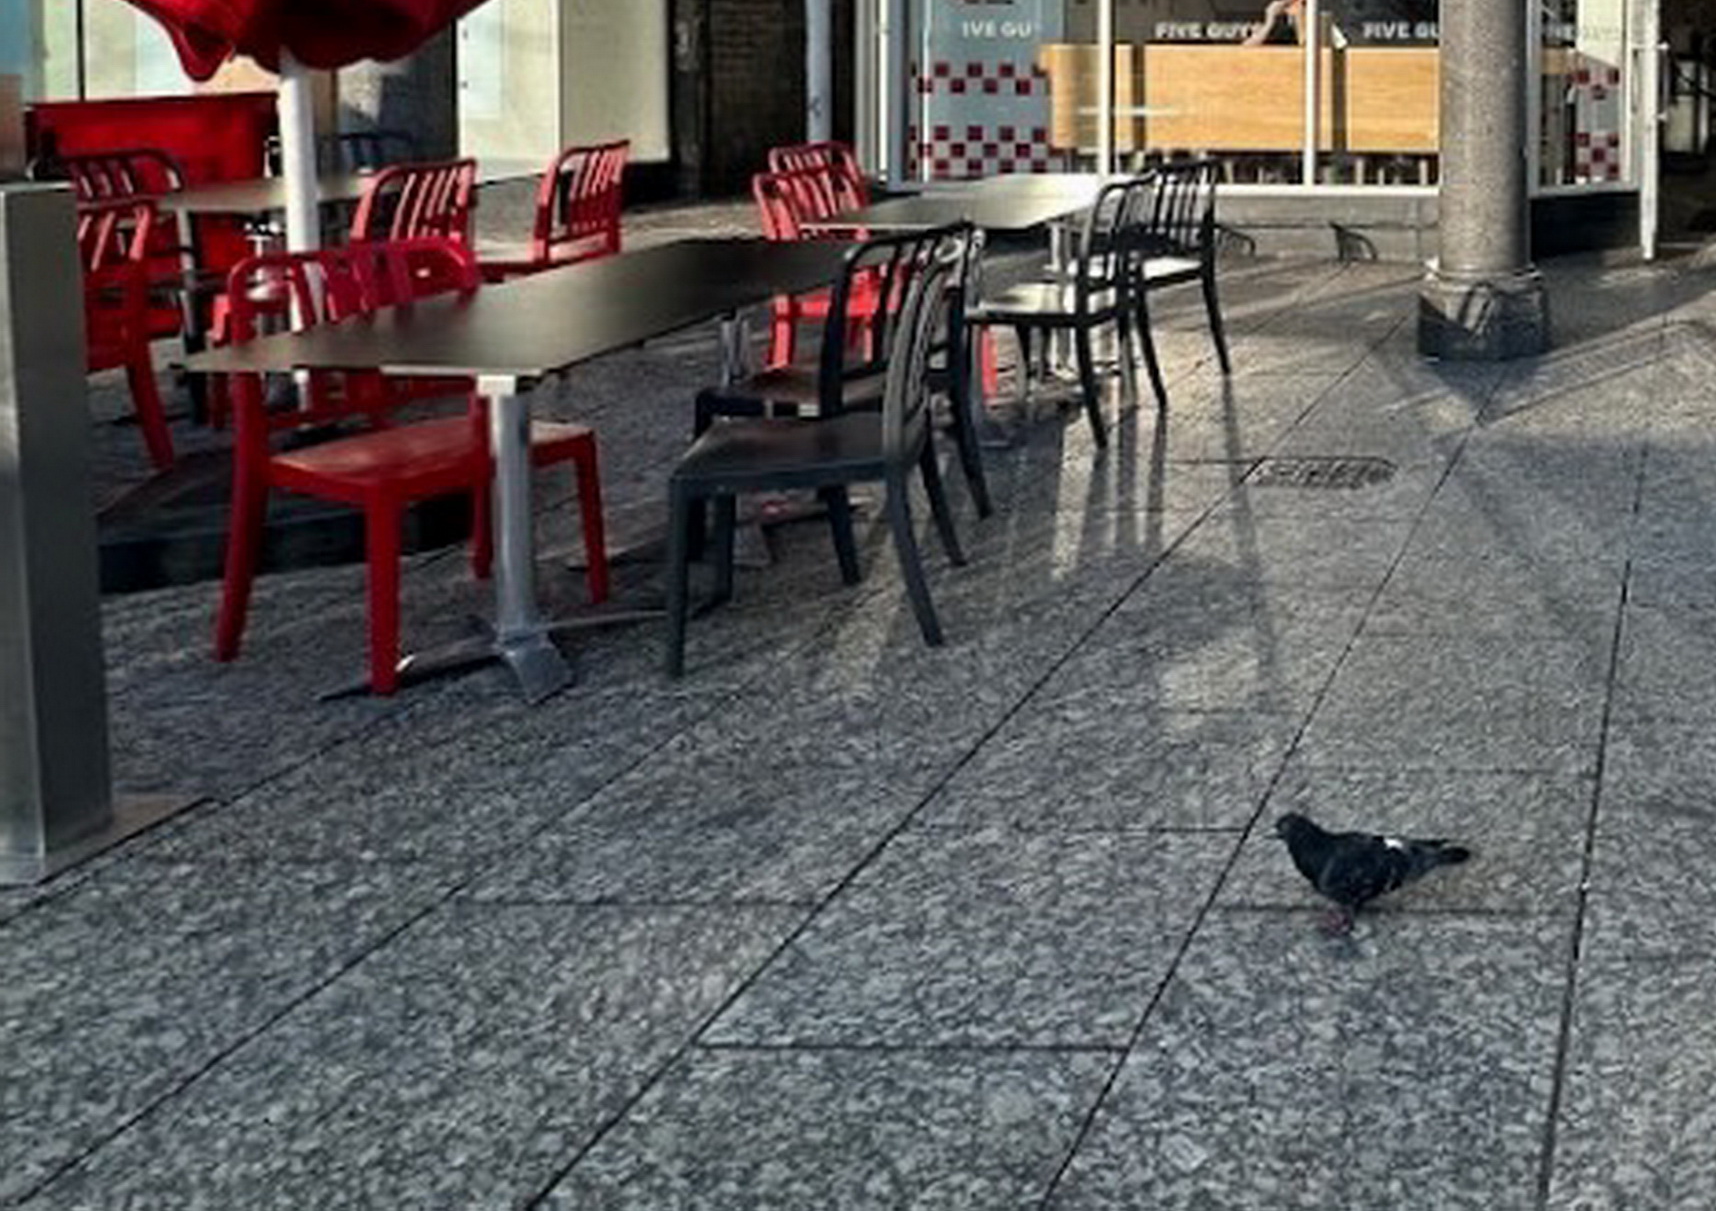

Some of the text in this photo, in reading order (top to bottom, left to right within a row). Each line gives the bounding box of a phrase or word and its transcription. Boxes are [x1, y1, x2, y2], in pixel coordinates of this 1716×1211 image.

[962, 21, 996, 38] IVE
[1155, 21, 1254, 39] FIVE GUY
[1362, 21, 1440, 39] FIVE GU
